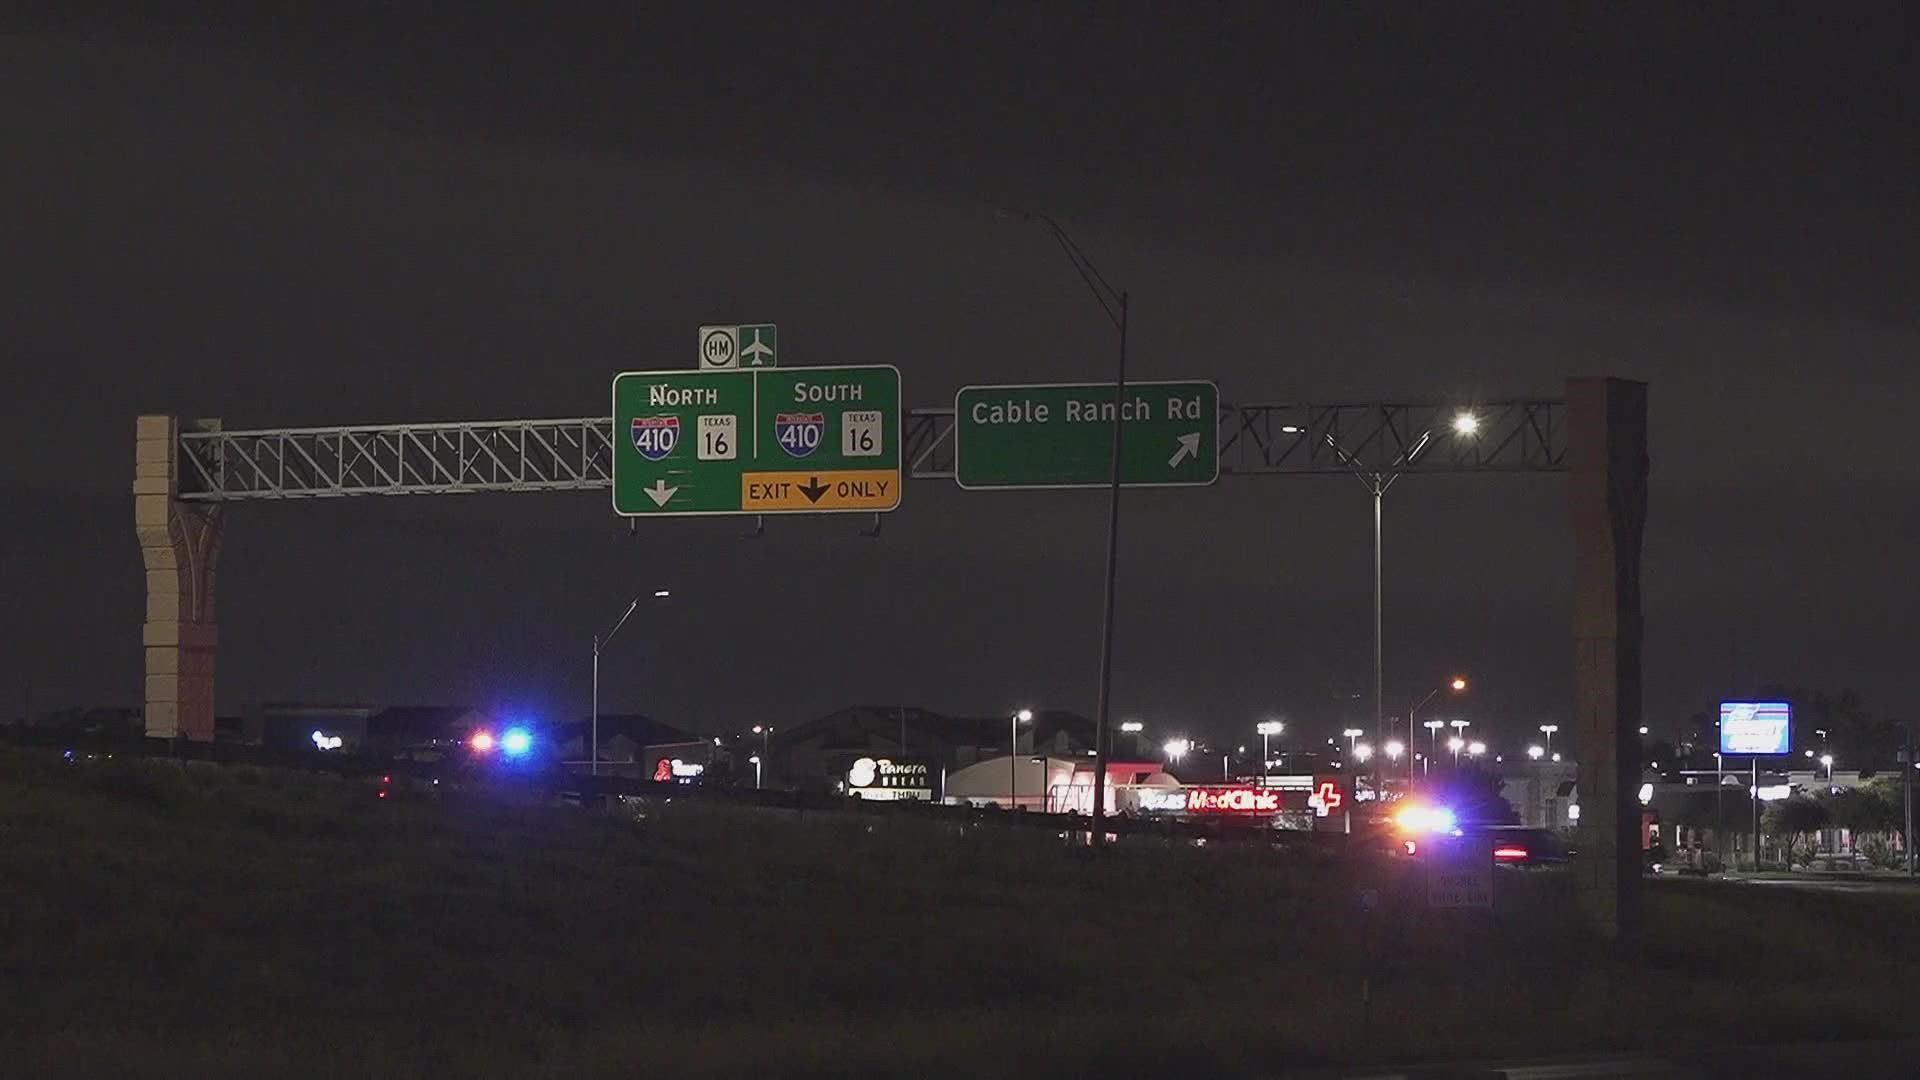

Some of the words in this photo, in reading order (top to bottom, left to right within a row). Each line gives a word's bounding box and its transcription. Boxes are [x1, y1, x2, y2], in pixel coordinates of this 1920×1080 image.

[708, 341, 729, 356] HM
[649, 383, 718, 406] NORTH
[794, 382, 863, 402] SOUTH
[848, 413, 876, 423] TEXAS
[971, 400, 1049, 424] Cable
[1065, 397, 1150, 422] Ranch
[1167, 396, 1201, 420] Rd
[703, 417, 731, 427] TEXAS
[636, 426, 675, 451] 410
[704, 431, 729, 455] 16
[780, 423, 819, 448] 410
[849, 428, 874, 451] 16
[749, 482, 791, 499] EXIT
[837, 481, 889, 498] ONLY
[1188, 790, 1279, 810] MedClinic
